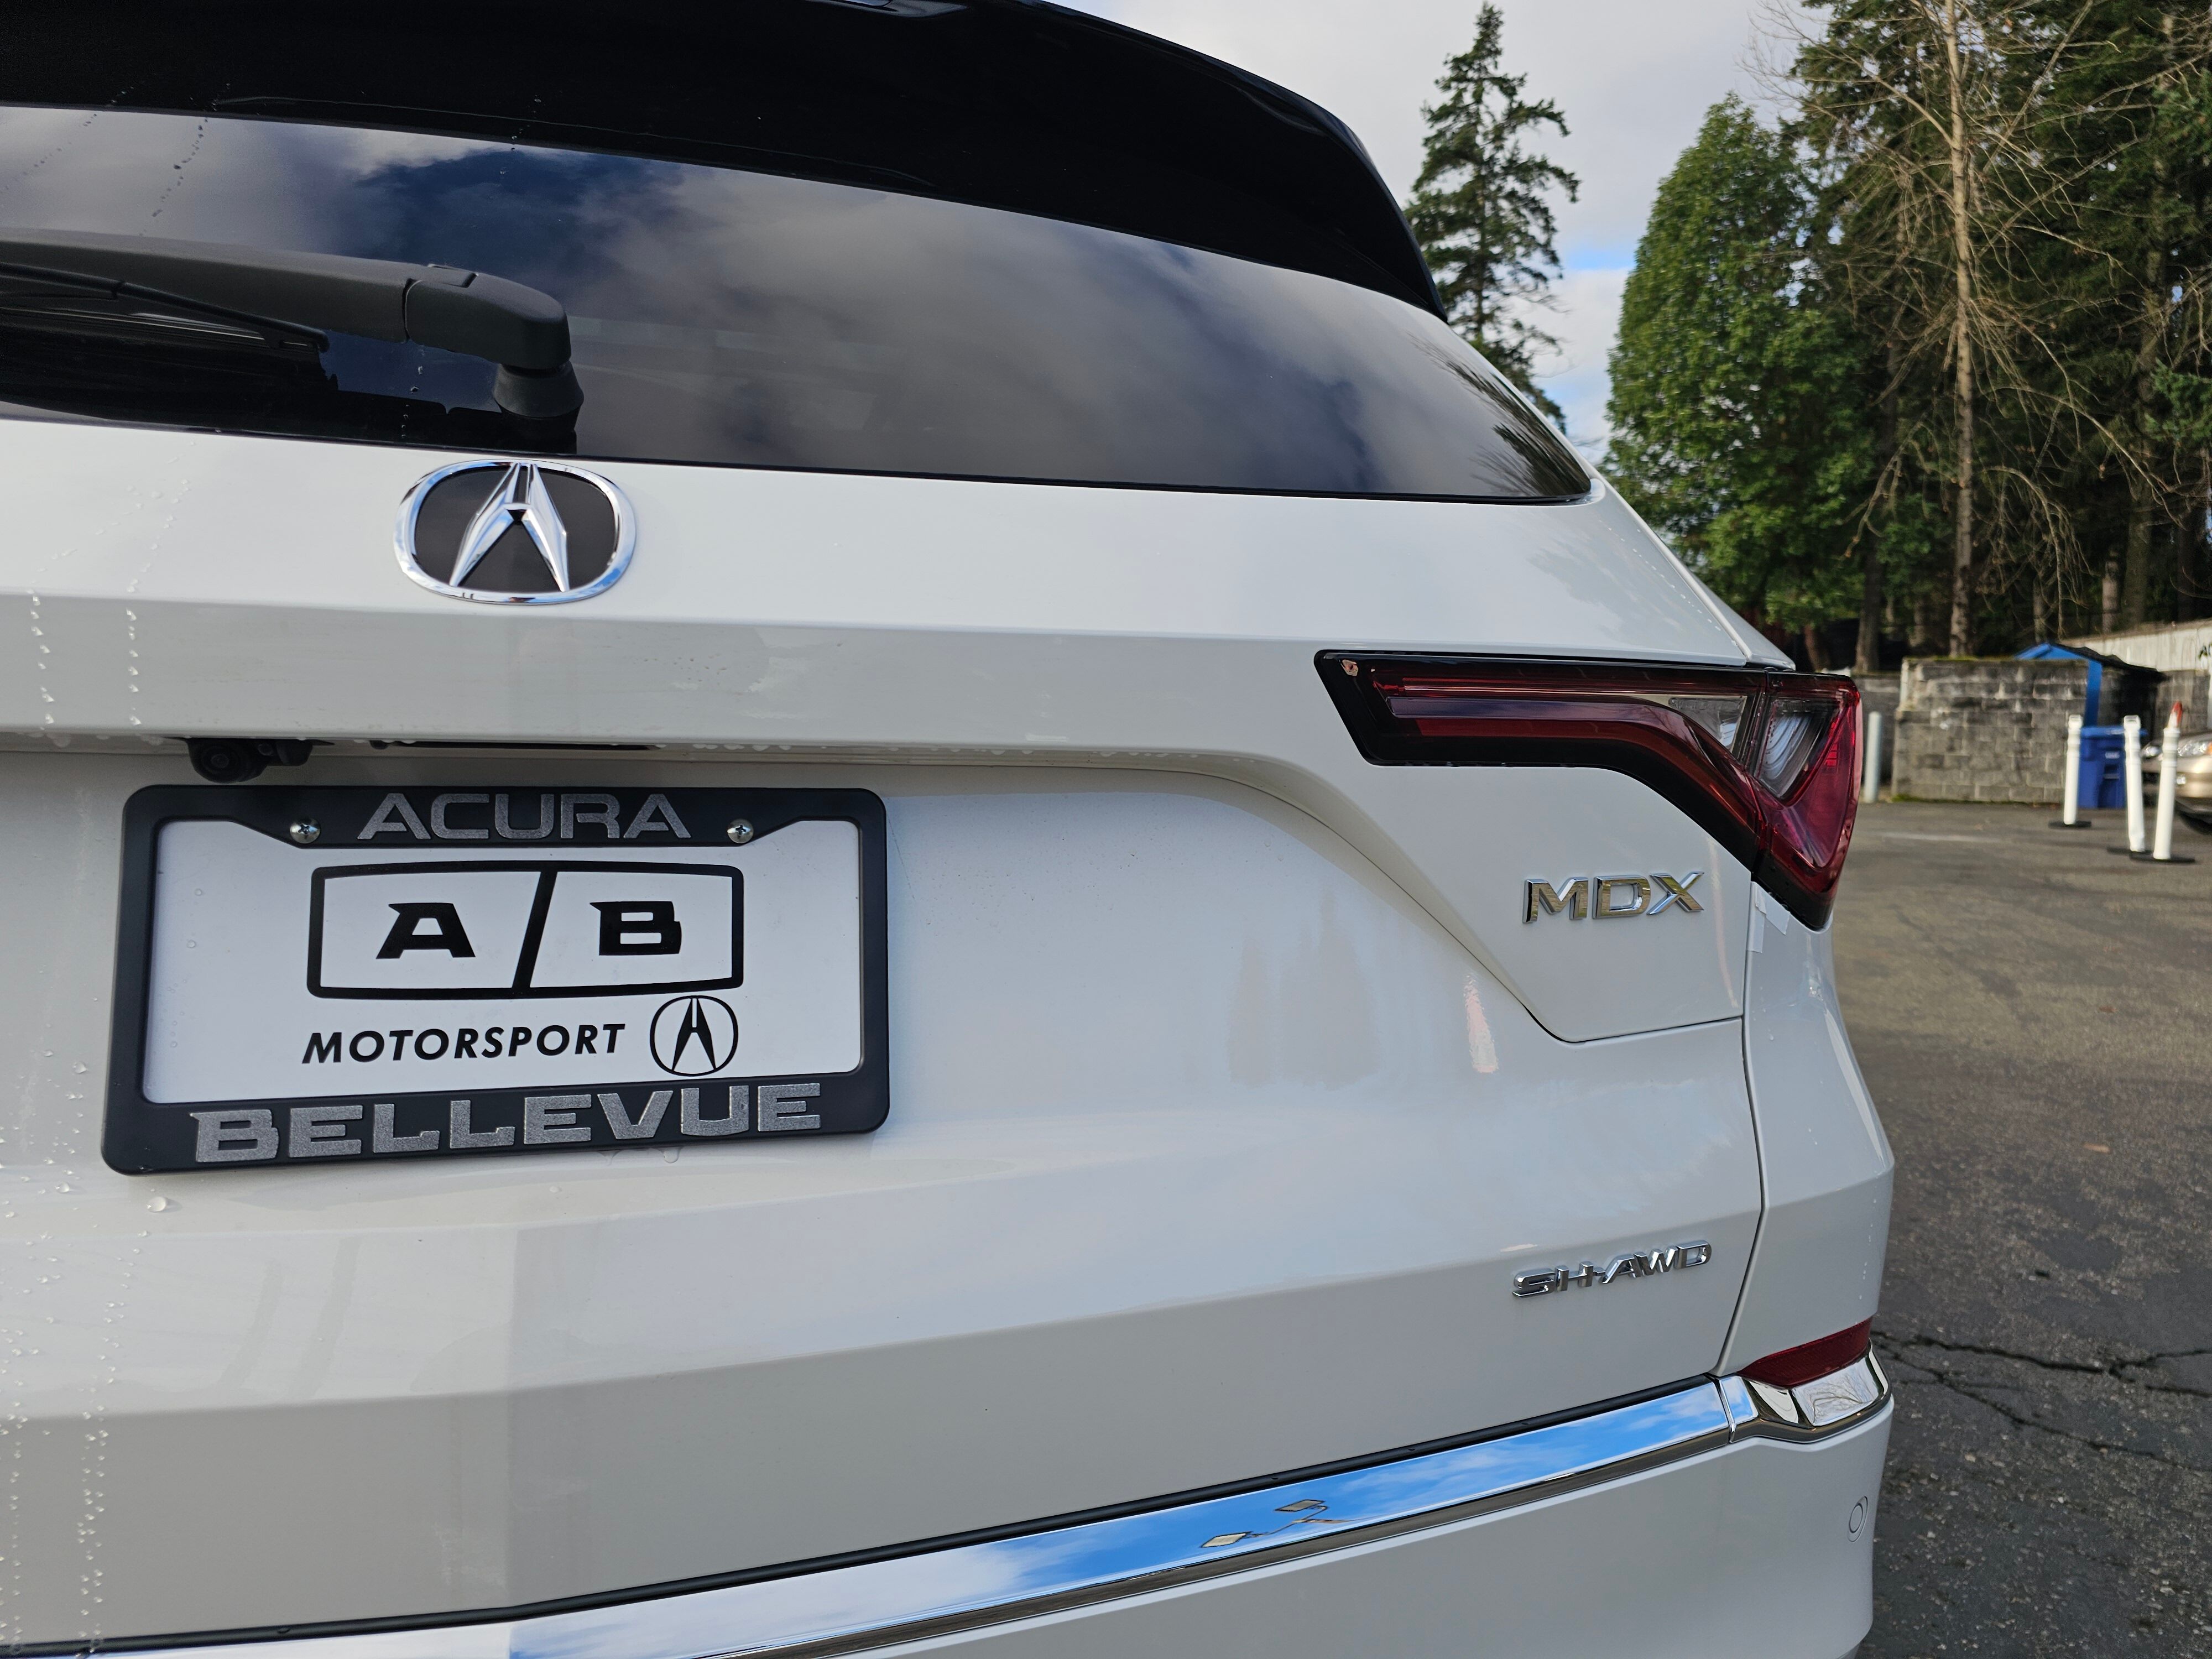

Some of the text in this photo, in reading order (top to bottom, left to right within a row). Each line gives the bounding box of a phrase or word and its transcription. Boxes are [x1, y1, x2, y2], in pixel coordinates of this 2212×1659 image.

[357, 793, 691, 840] ACURA
[1522, 870, 1705, 924] MDX
[376, 901, 682, 959] A B
[302, 1023, 625, 1064] MOTORSPORT
[190, 1082, 821, 1163] BELLEVUE
[1512, 1239, 1713, 1298] SH-AWD
